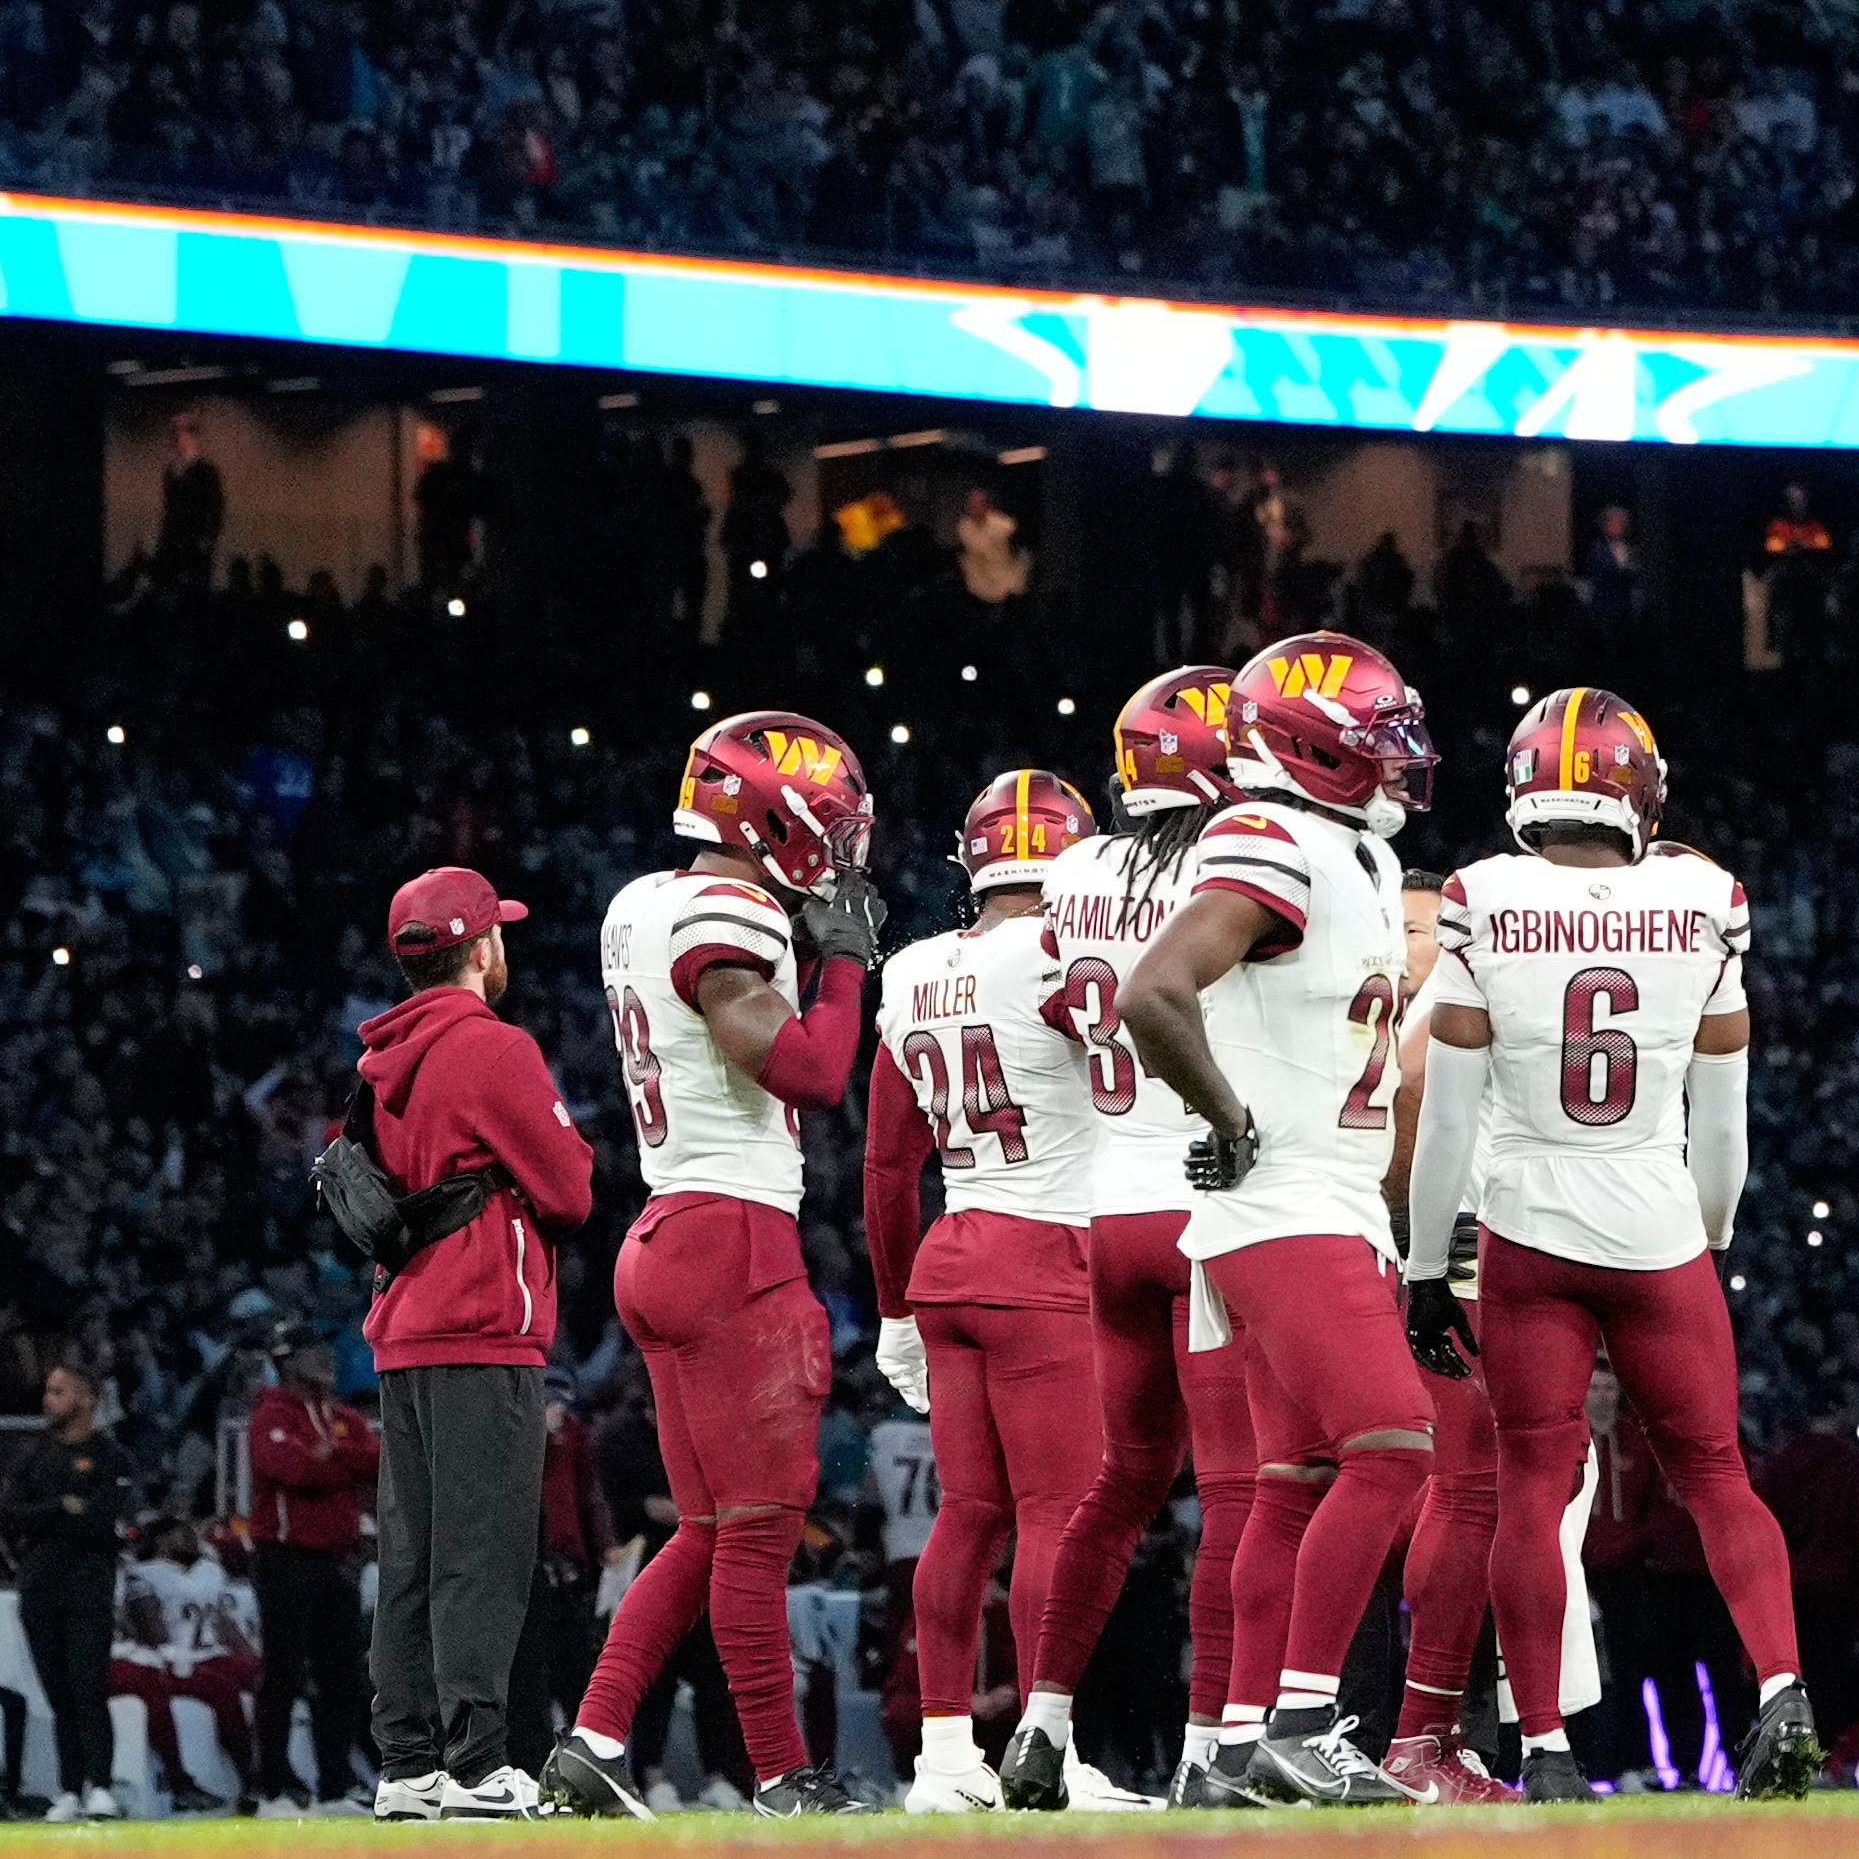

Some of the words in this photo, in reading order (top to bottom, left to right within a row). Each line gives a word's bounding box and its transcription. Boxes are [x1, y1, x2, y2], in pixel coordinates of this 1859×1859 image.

[1574, 750, 1590, 784] 6
[989, 868, 1049, 879] WASHINGT
[1489, 909, 1706, 953] IGBINOGHENE
[912, 974, 977, 1024] MILLER
[1338, 973, 1410, 1130] 2
[1560, 966, 1640, 1127] 6
[903, 1023, 1029, 1170] 24
